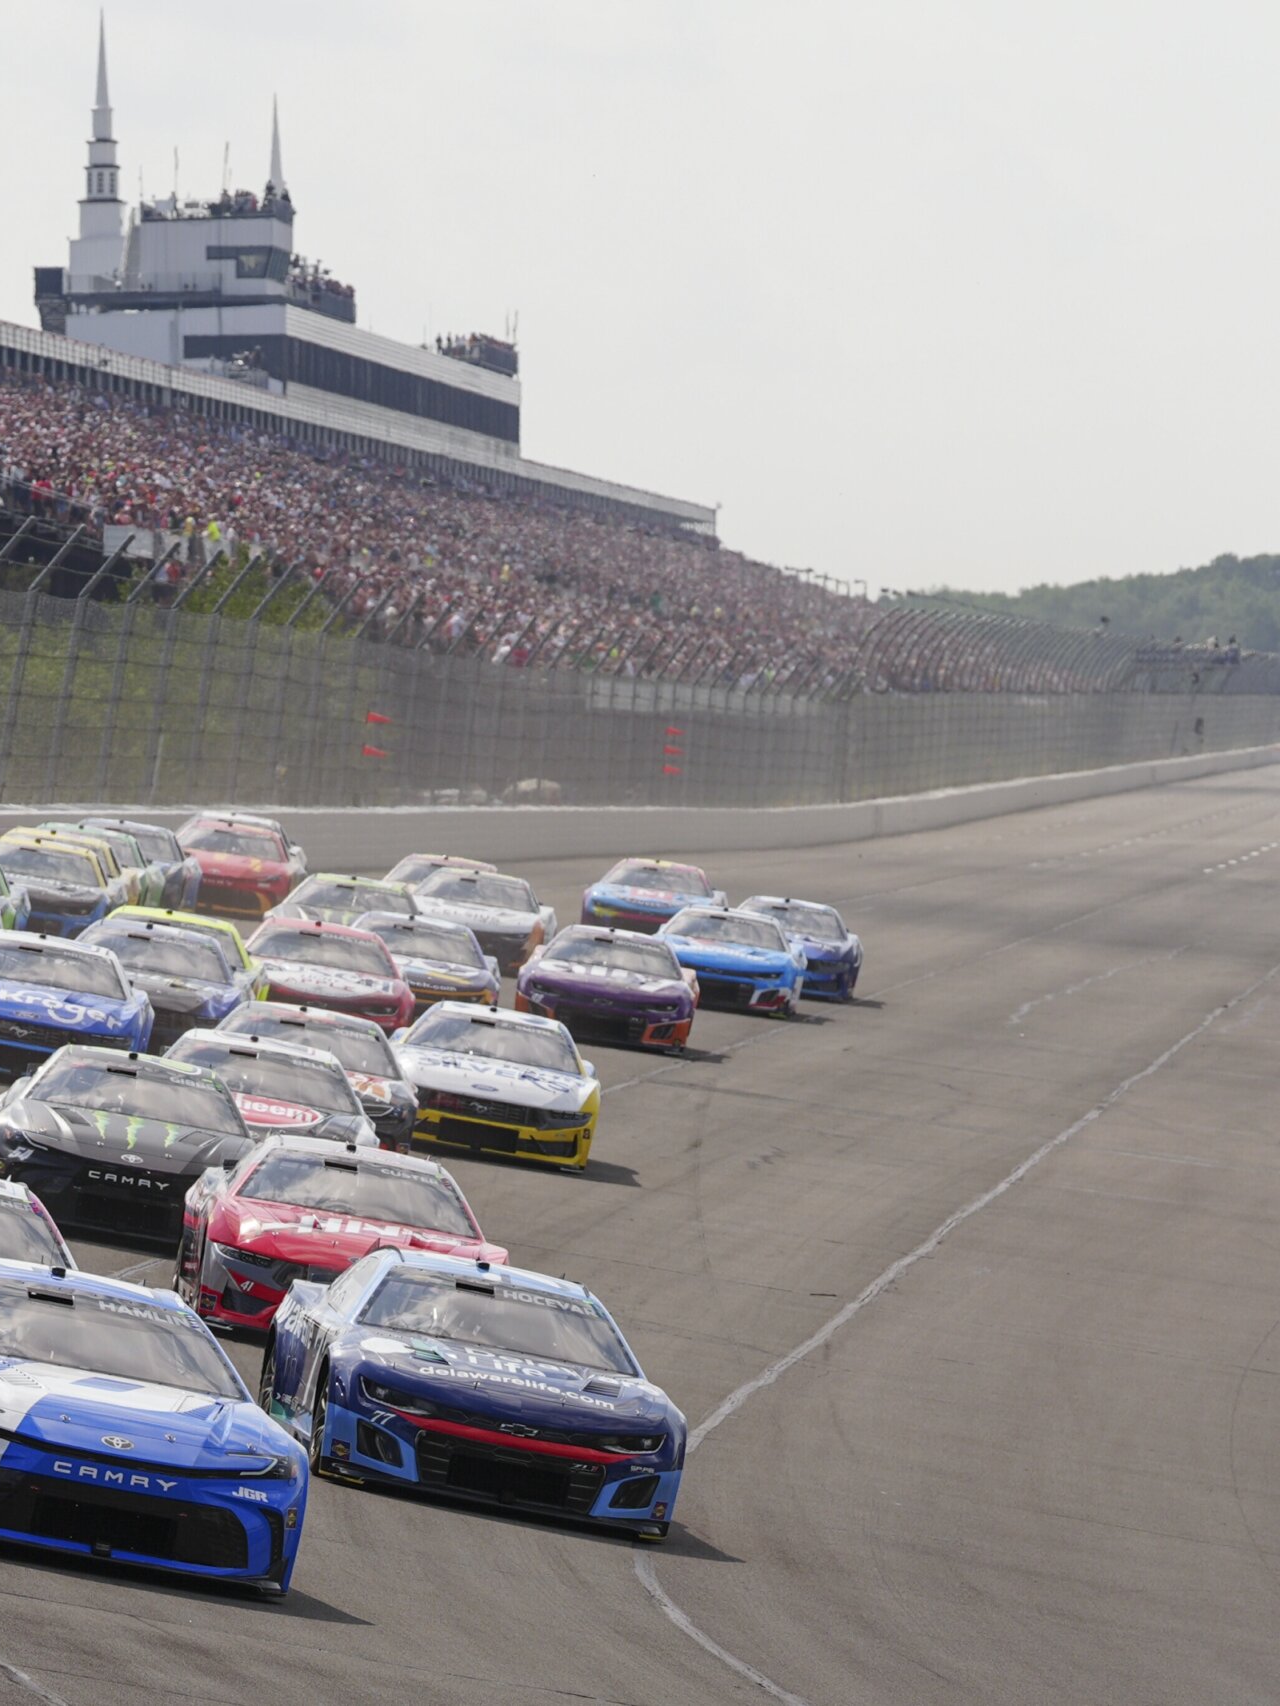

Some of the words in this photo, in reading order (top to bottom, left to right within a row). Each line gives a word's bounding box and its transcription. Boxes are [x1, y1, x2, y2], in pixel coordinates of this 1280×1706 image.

[235, 1093, 313, 1123] heem
[88, 1170, 170, 1191] CAMRY
[239, 1281, 254, 1292] 41
[98, 1300, 193, 1328] HAMLIN
[503, 1289, 598, 1318] HOCEVAR
[419, 1365, 615, 1411] delawarelife.com
[370, 1409, 396, 1426] 77
[53, 1460, 178, 1492] CAMRY
[231, 1486, 279, 1503] JGR
